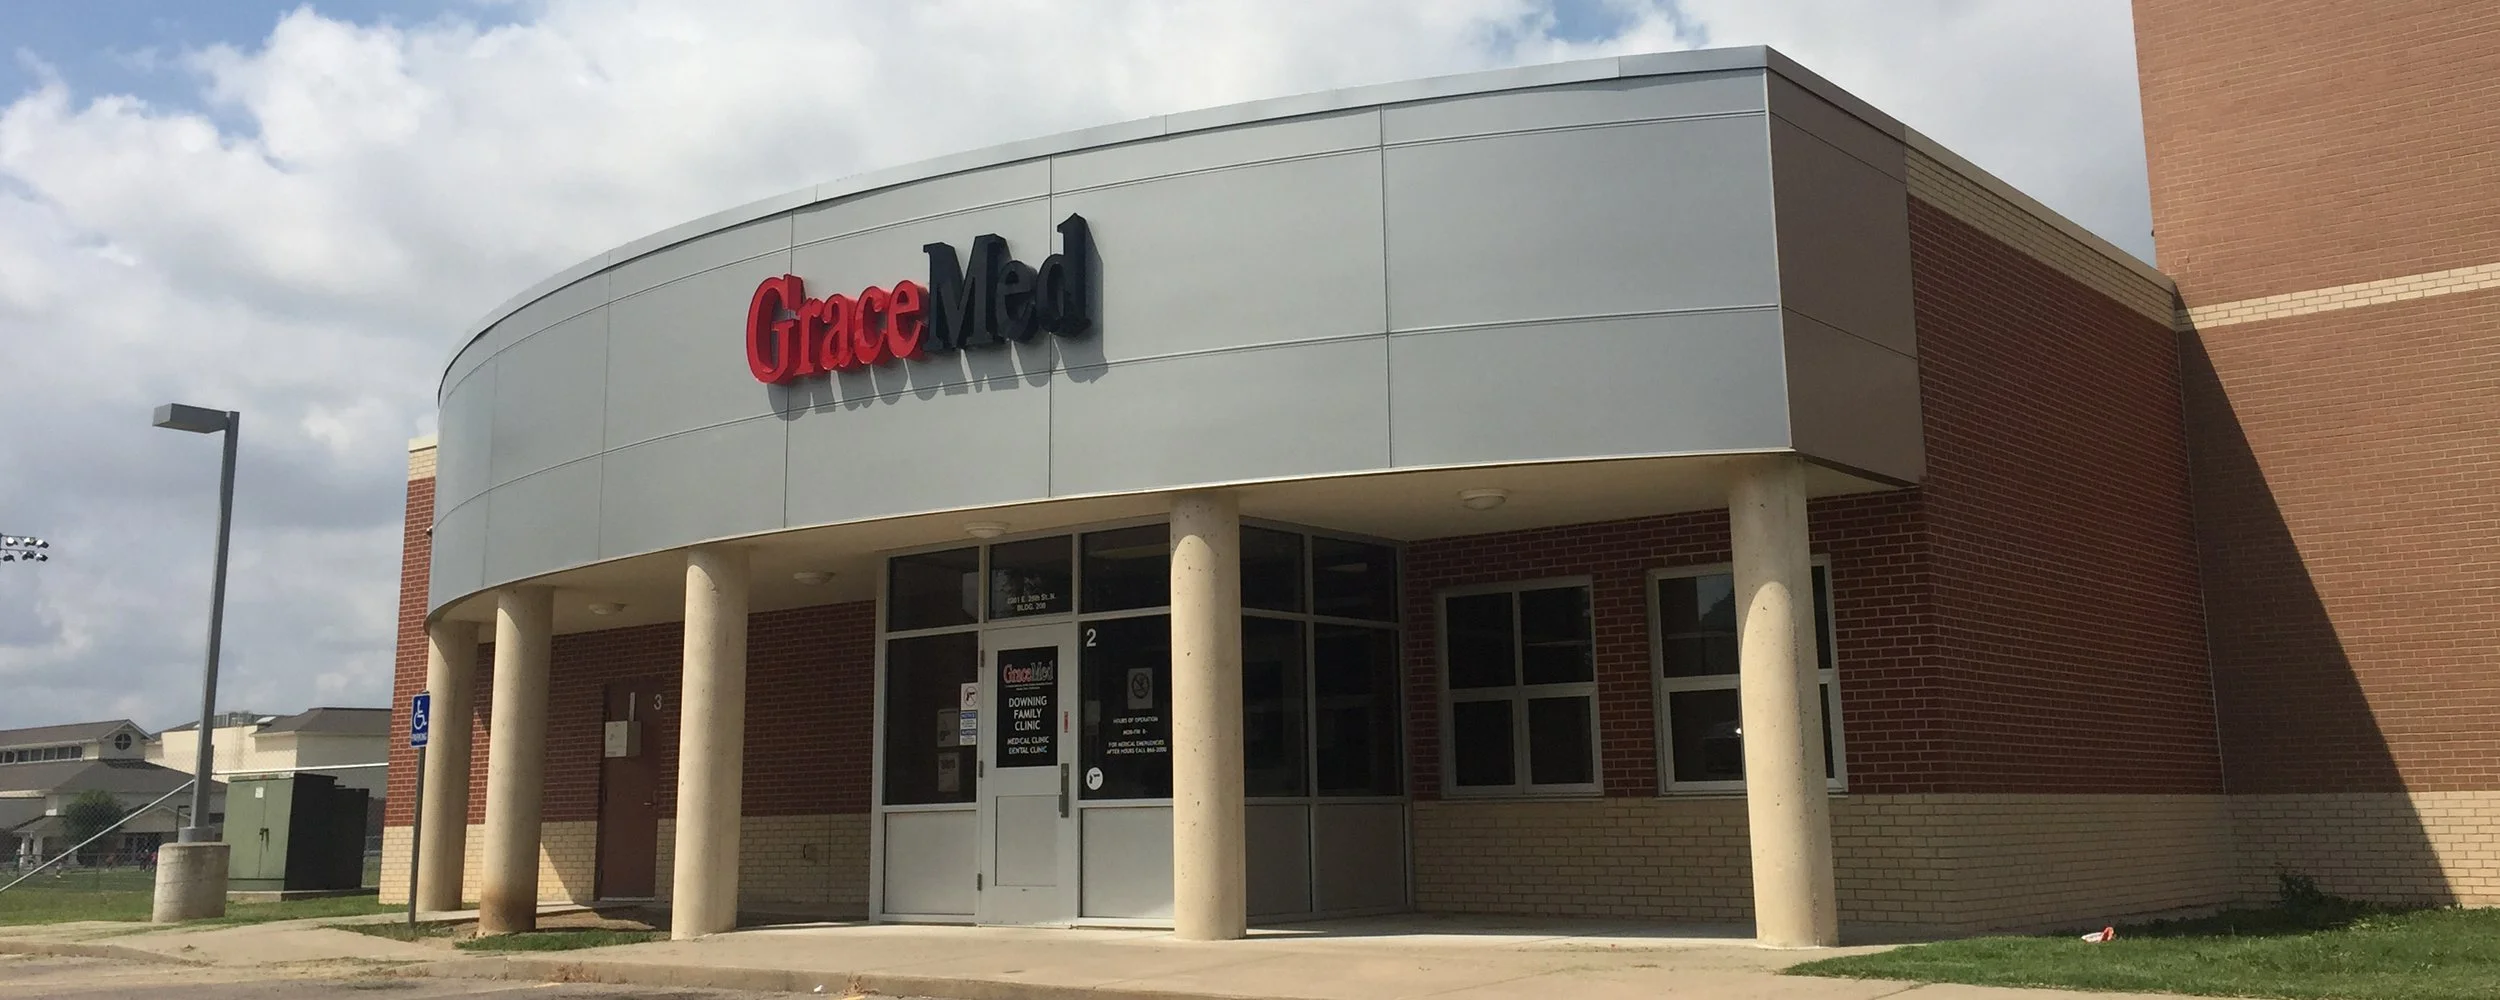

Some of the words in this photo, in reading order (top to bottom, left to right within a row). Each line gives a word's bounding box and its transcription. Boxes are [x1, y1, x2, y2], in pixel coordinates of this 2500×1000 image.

[746, 213, 1092, 385] GraceMed
[1086, 628, 1096, 647] 2
[1003, 660, 1053, 683] GraceMed
[653, 693, 662, 710] 3
[1009, 696, 1047, 707] DOWNING
[1013, 708, 1042, 719] FAMILY
[1014, 720, 1040, 731] CLINIC
[1007, 737, 1030, 745] MEDICAL
[1031, 736, 1049, 744] CLINIC
[1009, 747, 1029, 755] DENTAL
[1030, 745, 1047, 754] CLINIC
